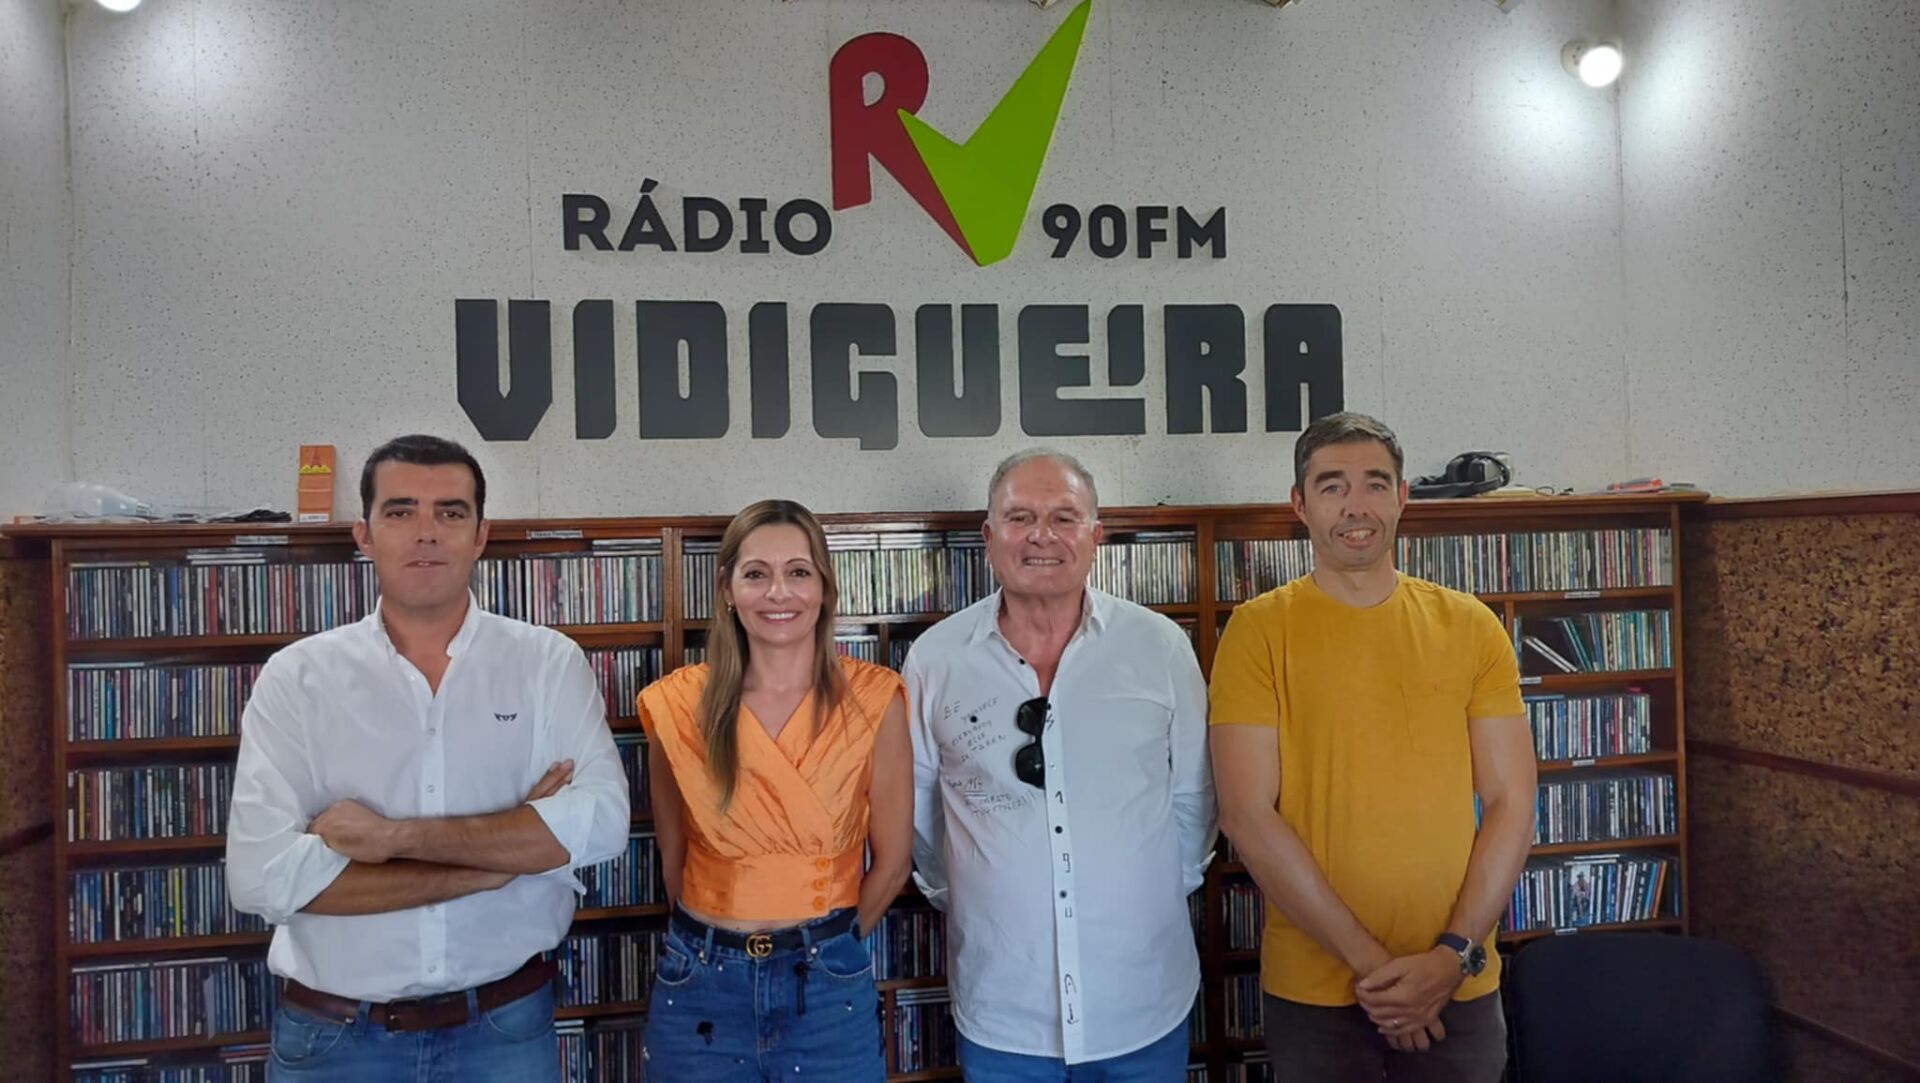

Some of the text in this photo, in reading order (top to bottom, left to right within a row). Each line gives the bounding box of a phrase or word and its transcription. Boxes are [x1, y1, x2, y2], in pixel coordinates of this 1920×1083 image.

[562, 178, 832, 256] RÁDIO
[1041, 203, 1227, 259] 90FM
[454, 298, 1346, 450] VIDIGUEIRA
